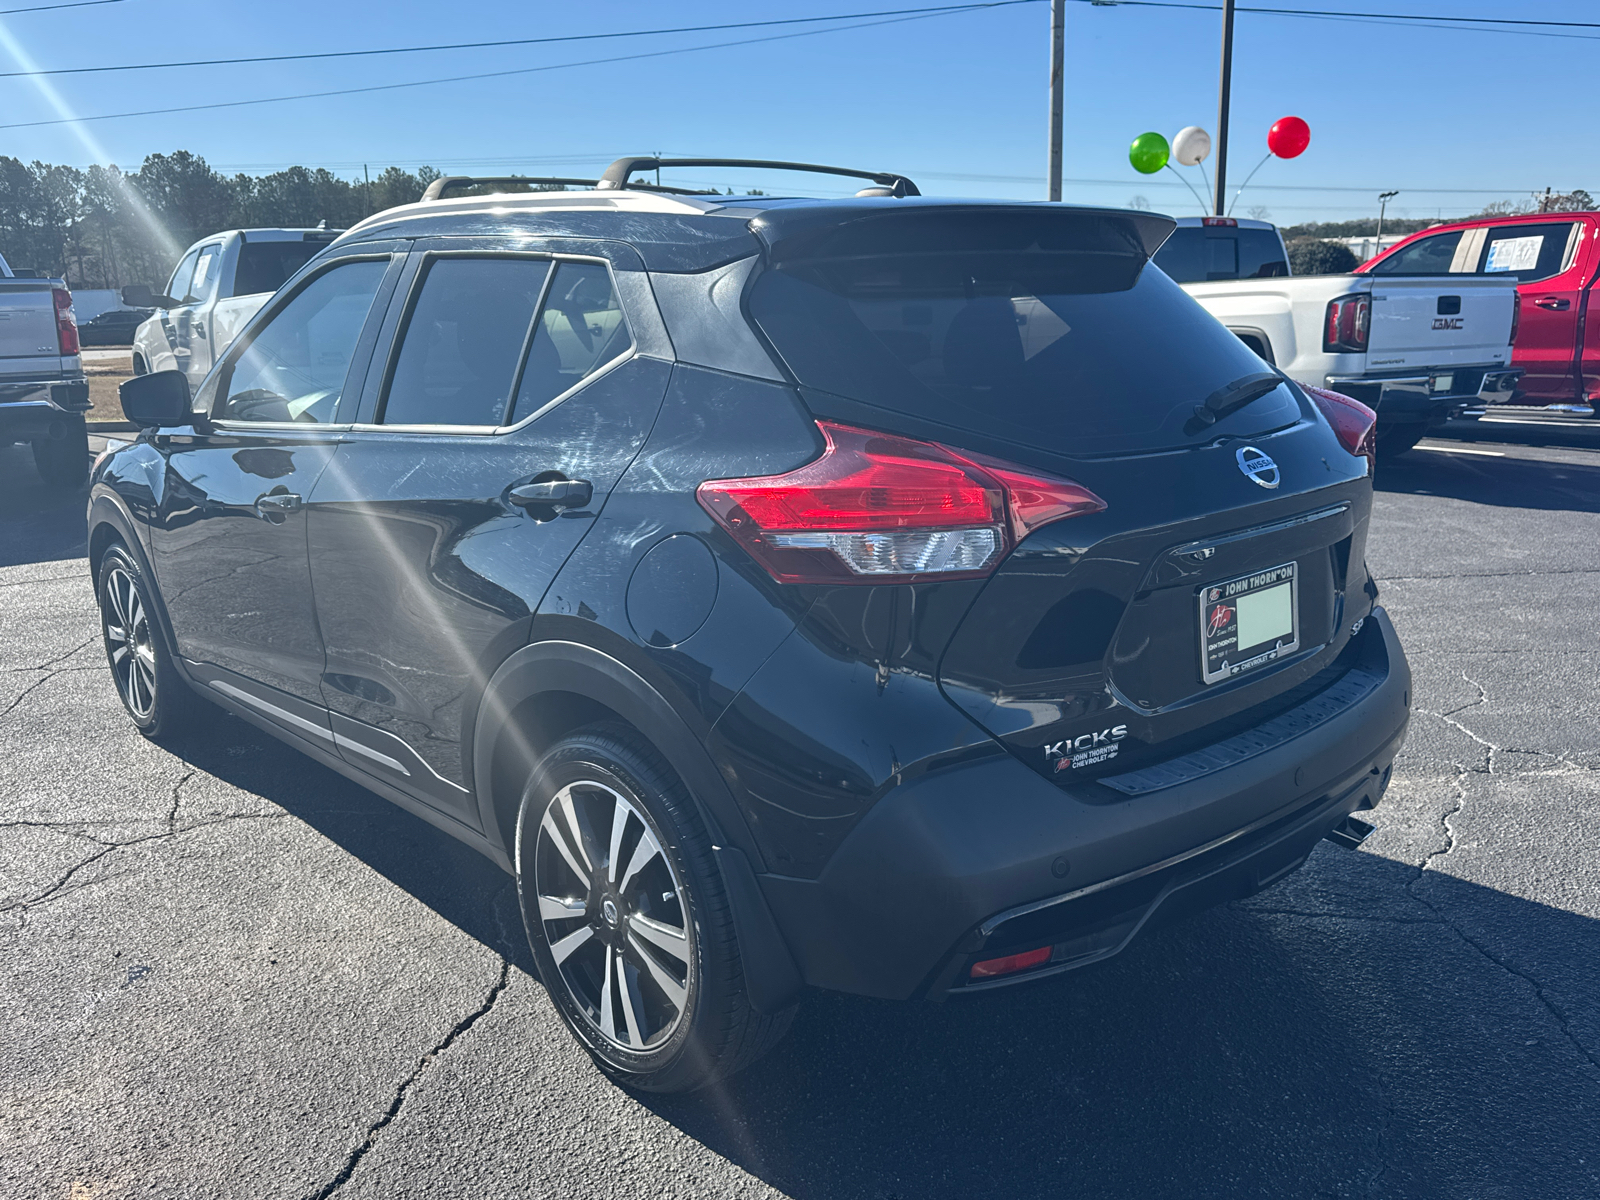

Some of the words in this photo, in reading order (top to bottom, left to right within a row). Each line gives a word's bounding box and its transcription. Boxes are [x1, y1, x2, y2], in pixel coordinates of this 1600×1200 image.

[1431, 318, 1464, 330] GMC
[1225, 579, 1248, 597] JOHN
[1241, 655, 1268, 670] CHEVROLET
[1043, 724, 1128, 760] KICKS
[1071, 753, 1108, 769] CHEVROLET
[1072, 752, 1088, 763] JOHN
[1088, 743, 1119, 758] THORNTON
